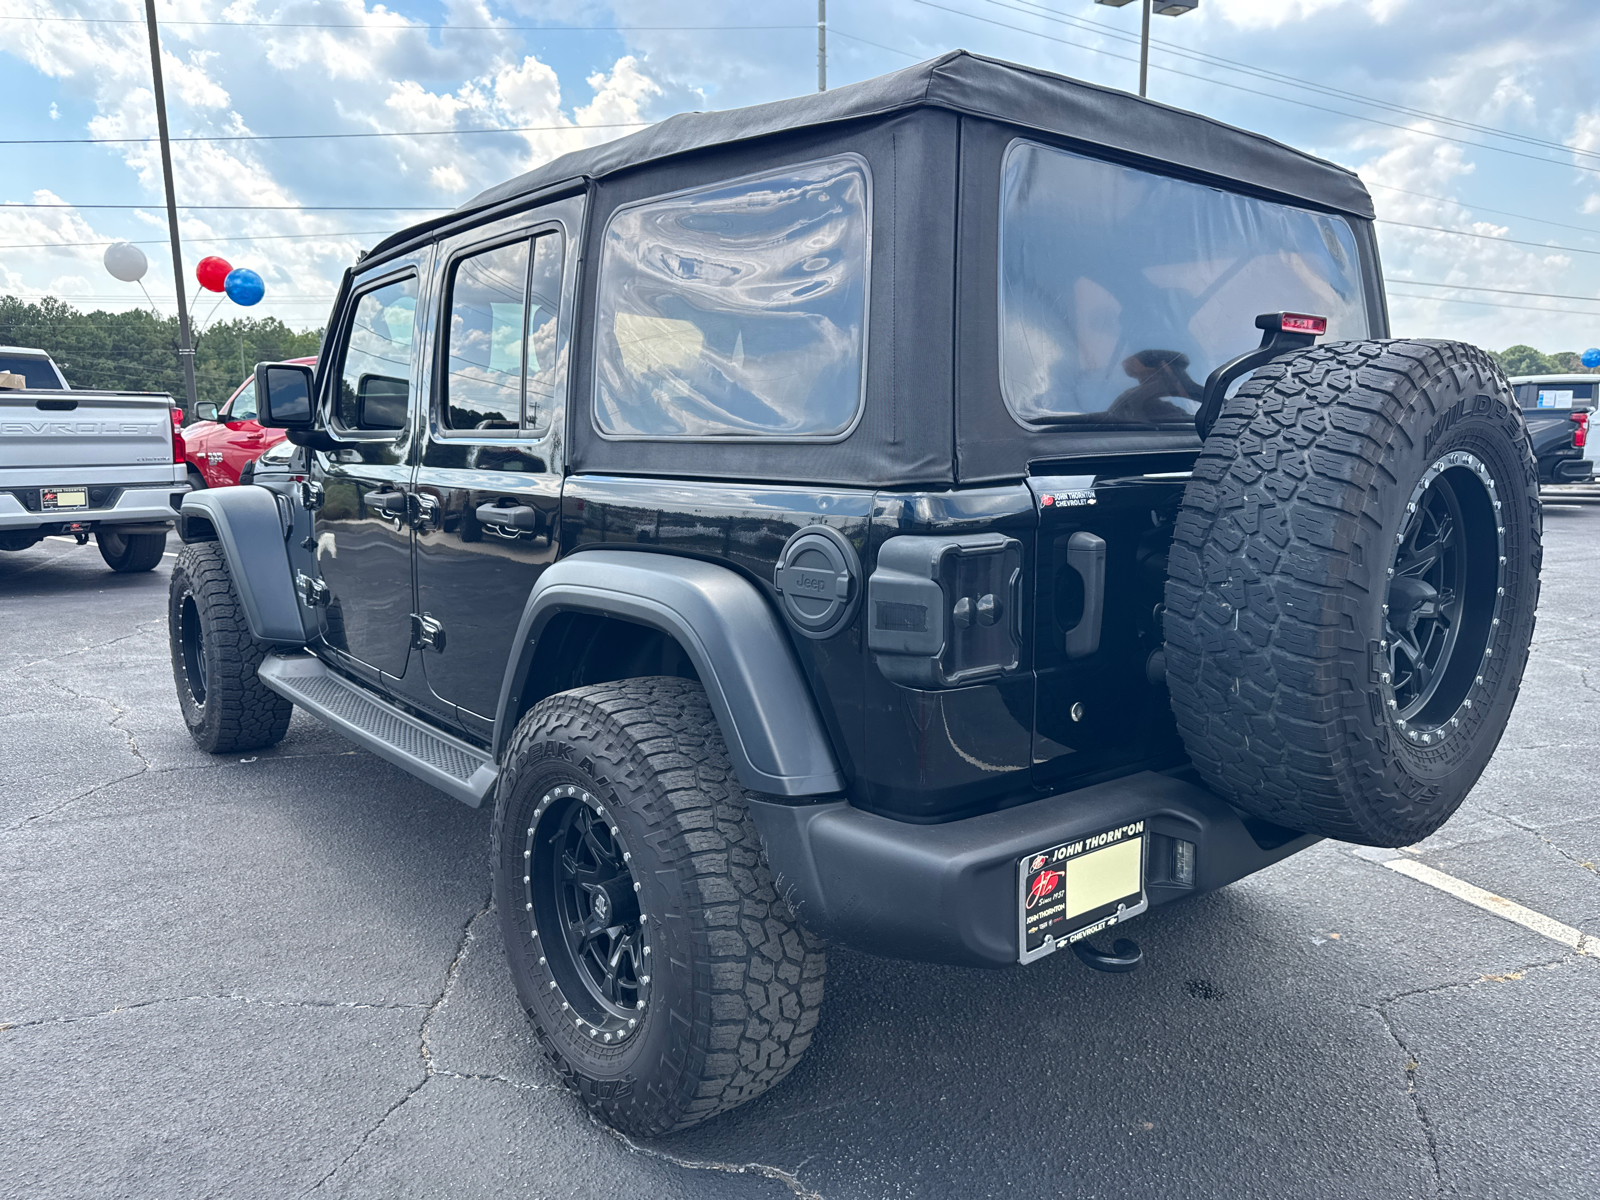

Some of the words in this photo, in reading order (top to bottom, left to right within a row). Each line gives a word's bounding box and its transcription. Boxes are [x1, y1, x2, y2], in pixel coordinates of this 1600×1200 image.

[1054, 492, 1068, 501] JOHN
[1068, 490, 1096, 500] THORNTON
[1055, 499, 1087, 507] CHEVROLET
[796, 573, 826, 593] Jeep
[1052, 842, 1083, 863] JOHN
[1038, 897, 1052, 907] Since
[1026, 914, 1039, 925] JOHN
[1039, 903, 1065, 919] THORNTON
[1069, 921, 1106, 943] CHEVROLET
